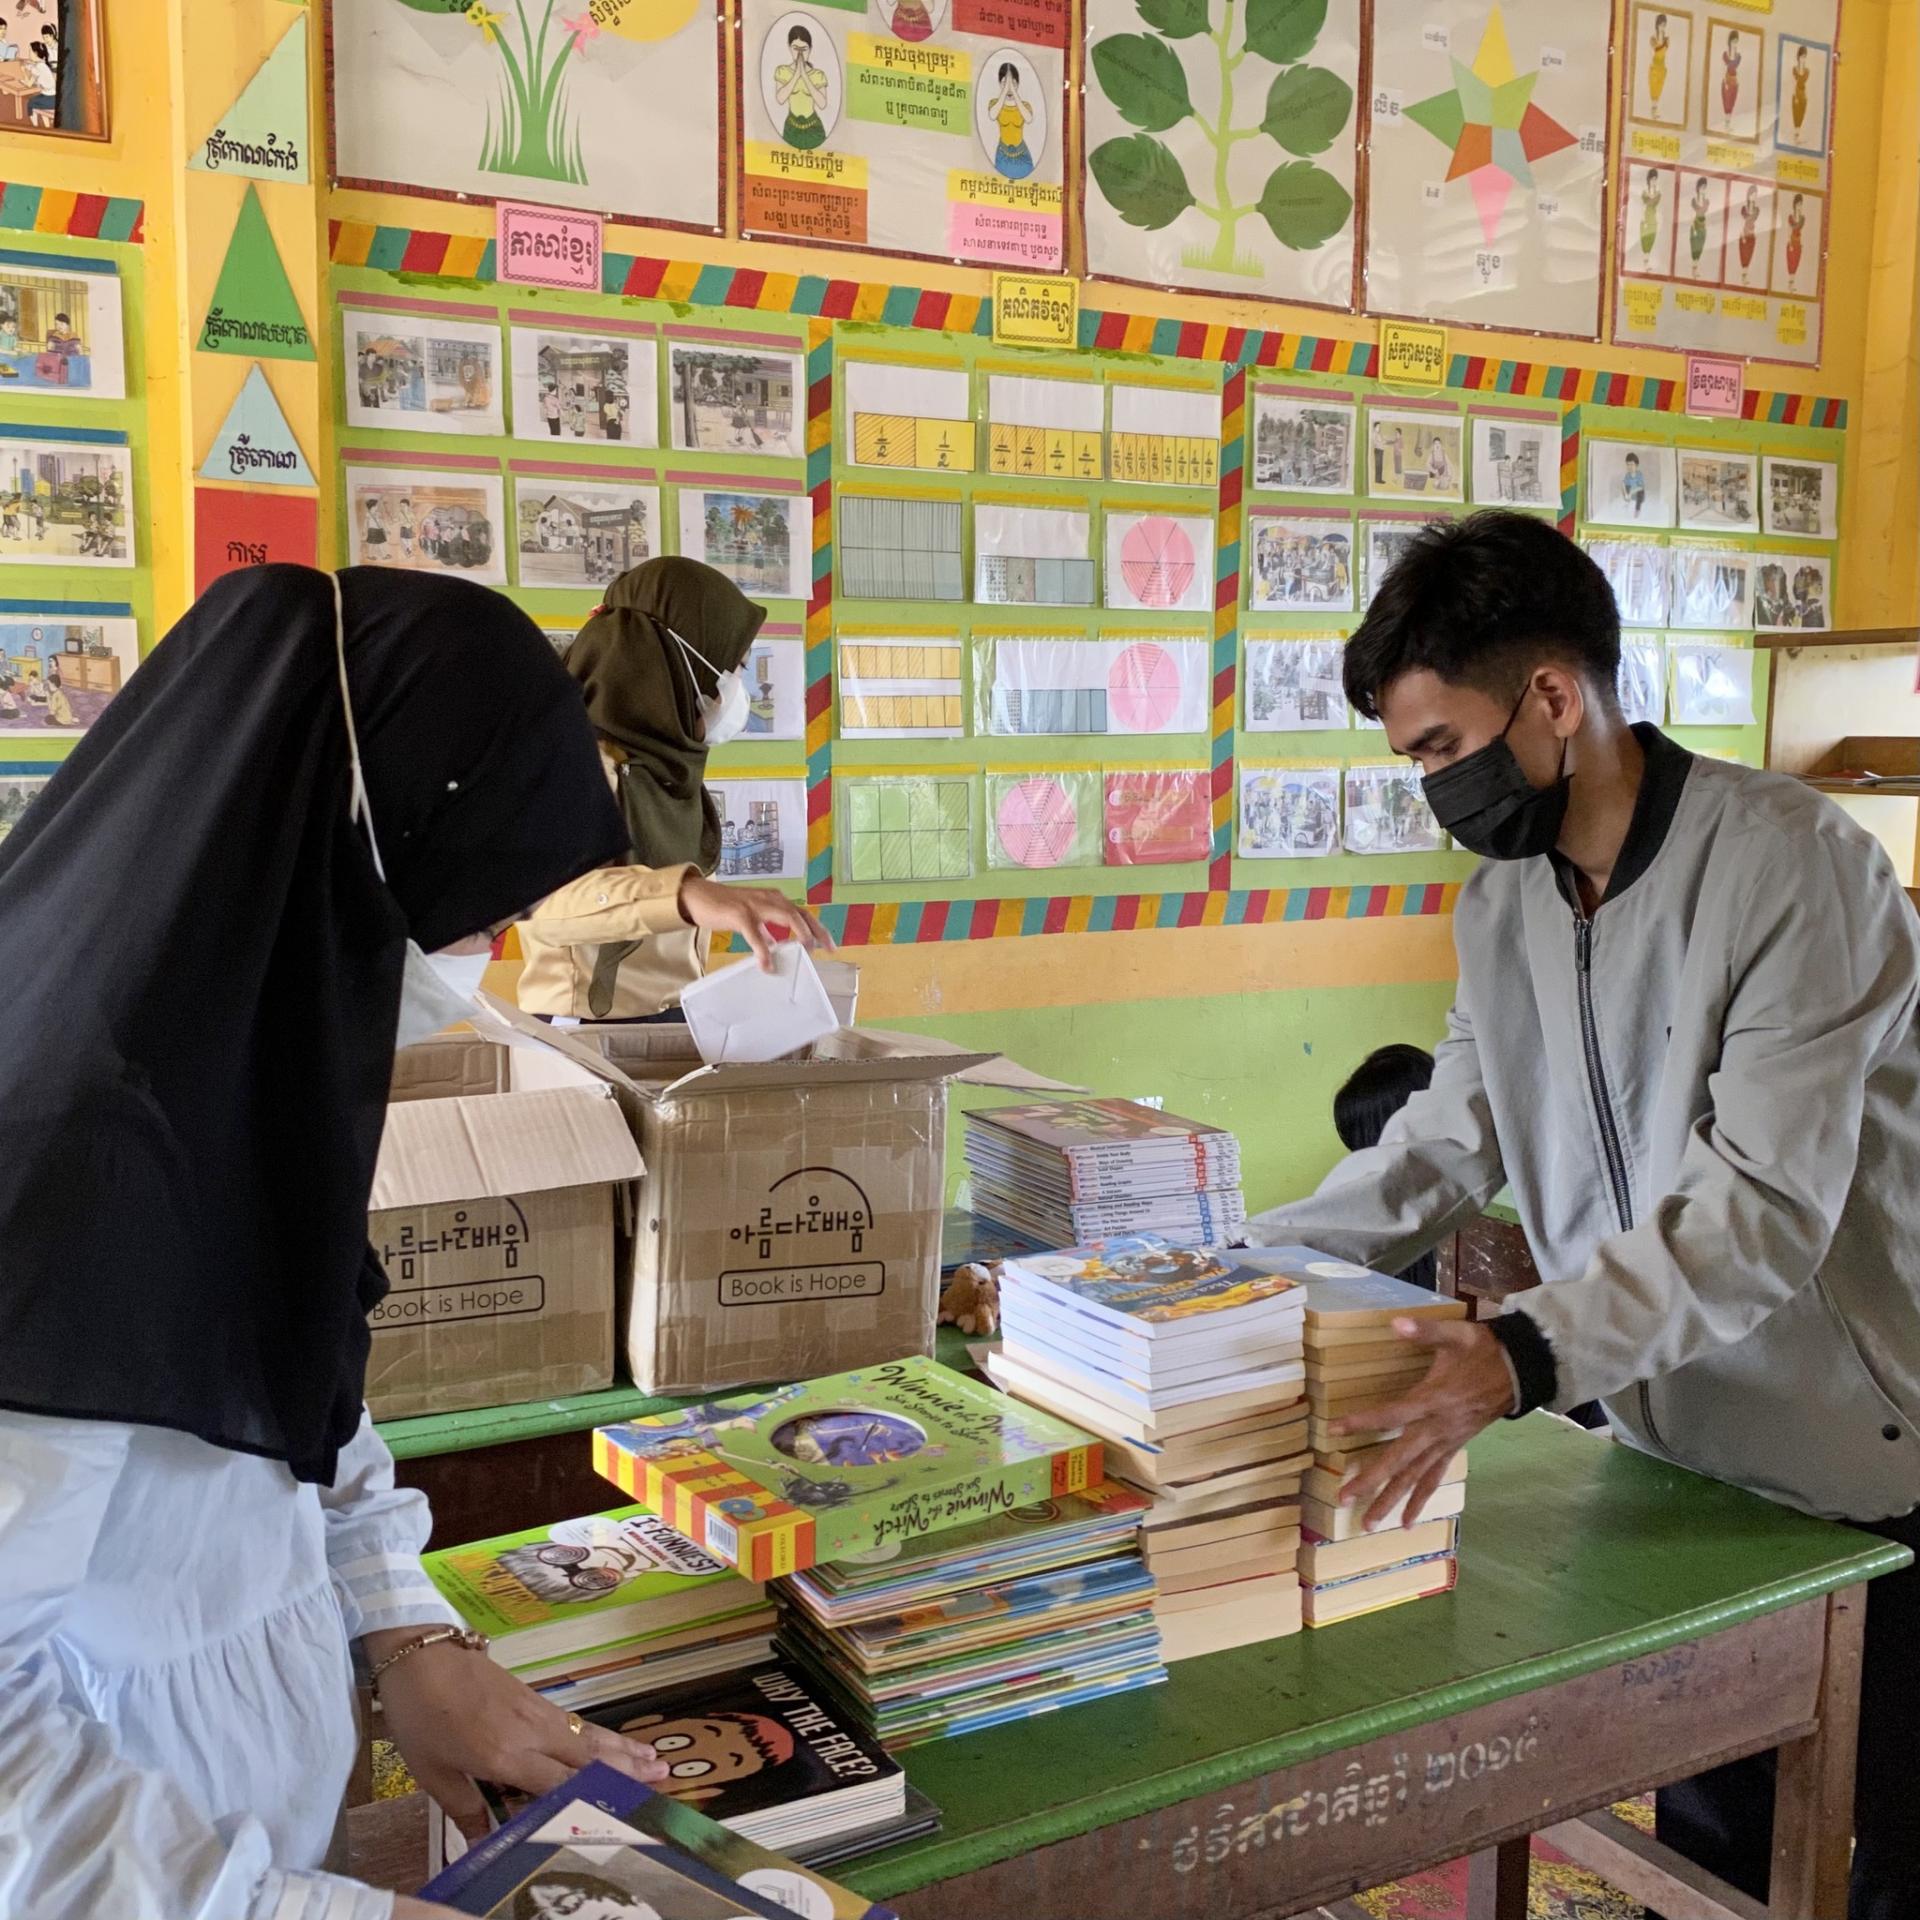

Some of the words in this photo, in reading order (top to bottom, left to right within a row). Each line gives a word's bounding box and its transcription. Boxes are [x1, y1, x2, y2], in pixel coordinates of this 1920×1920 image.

[511, 225, 592, 275] ភាសាខ្មែរ
[1003, 287, 1069, 332] គណិតវិទ្យា
[730, 1195, 865, 1259] 아름다운배움
[732, 1276, 785, 1297] Book
[791, 1274, 803, 1293] is
[810, 1273, 866, 1293] Hope
[373, 1296, 434, 1321] Book
[439, 1294, 453, 1313] is
[460, 1289, 524, 1311] Hope
[871, 1365, 965, 1412] Winnie
[947, 1480, 1015, 1513] Winnie
[966, 1476, 982, 1491] Six
[630, 1517, 658, 1528] I
[873, 1508, 929, 1546] Witch
[752, 1671, 809, 1701] WHY
[783, 1702, 837, 1736] THE
[808, 1732, 878, 1777] FACE?
